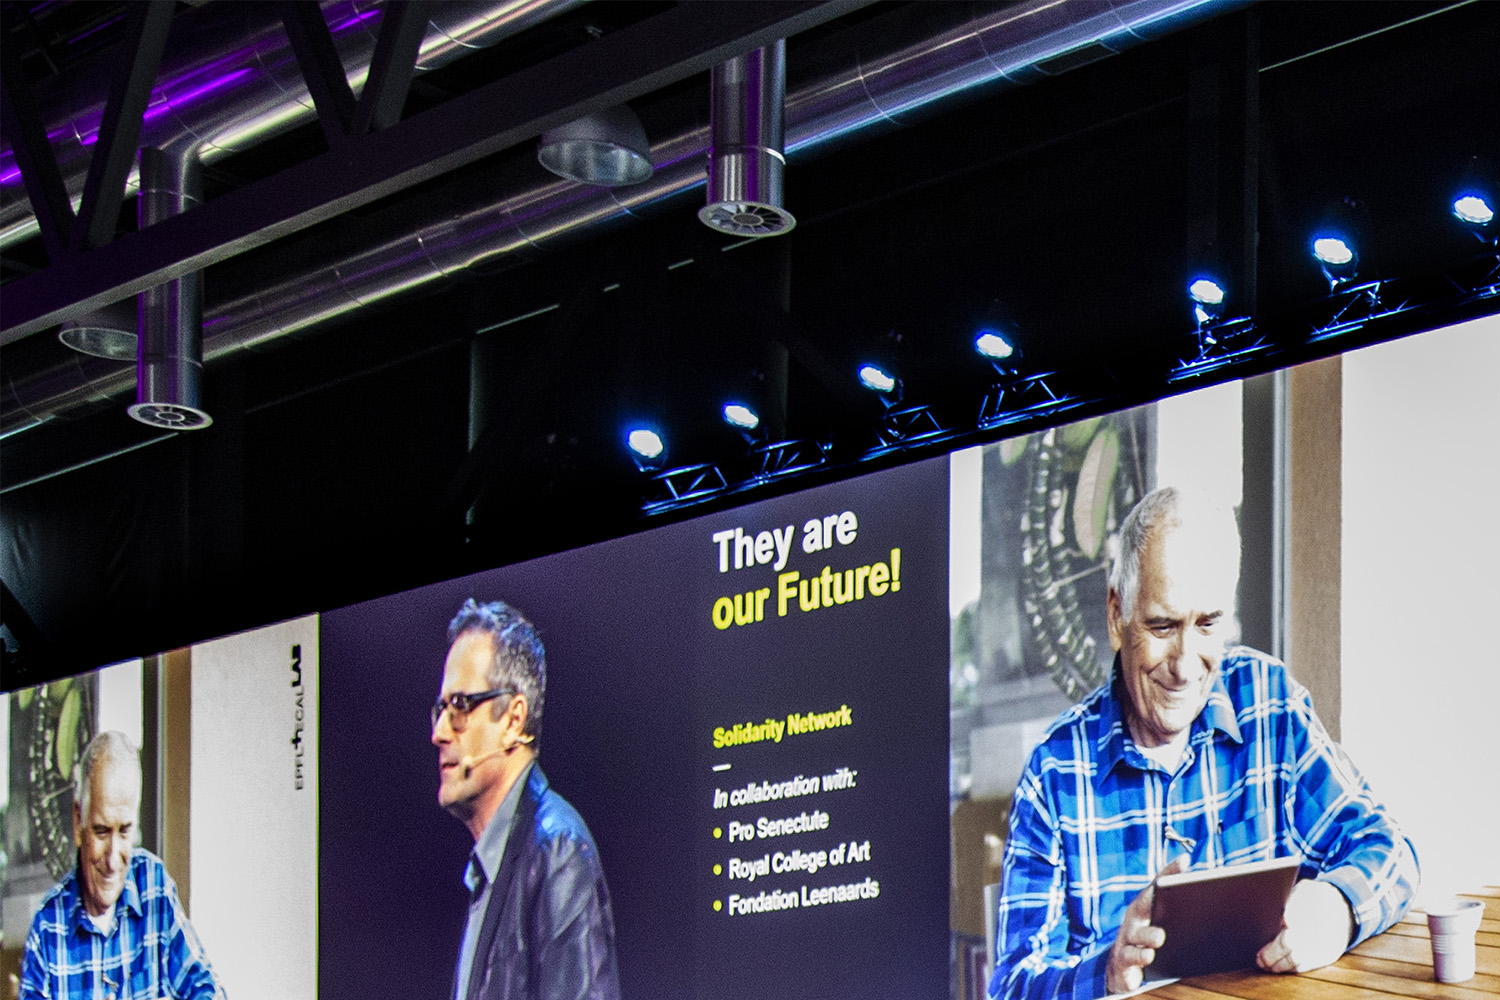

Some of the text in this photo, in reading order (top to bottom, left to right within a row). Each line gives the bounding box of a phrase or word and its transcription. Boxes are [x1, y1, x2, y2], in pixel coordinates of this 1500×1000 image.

[713, 511, 858, 573] They are
[713, 548, 901, 630] our Future!
[713, 705, 852, 749] Solidarity Network
[713, 767, 858, 809] In collaboration with:
[729, 810, 830, 843] Pro Senectute
[729, 840, 871, 882] Royal College of Art
[729, 877, 880, 916] Fondation Leenaards
